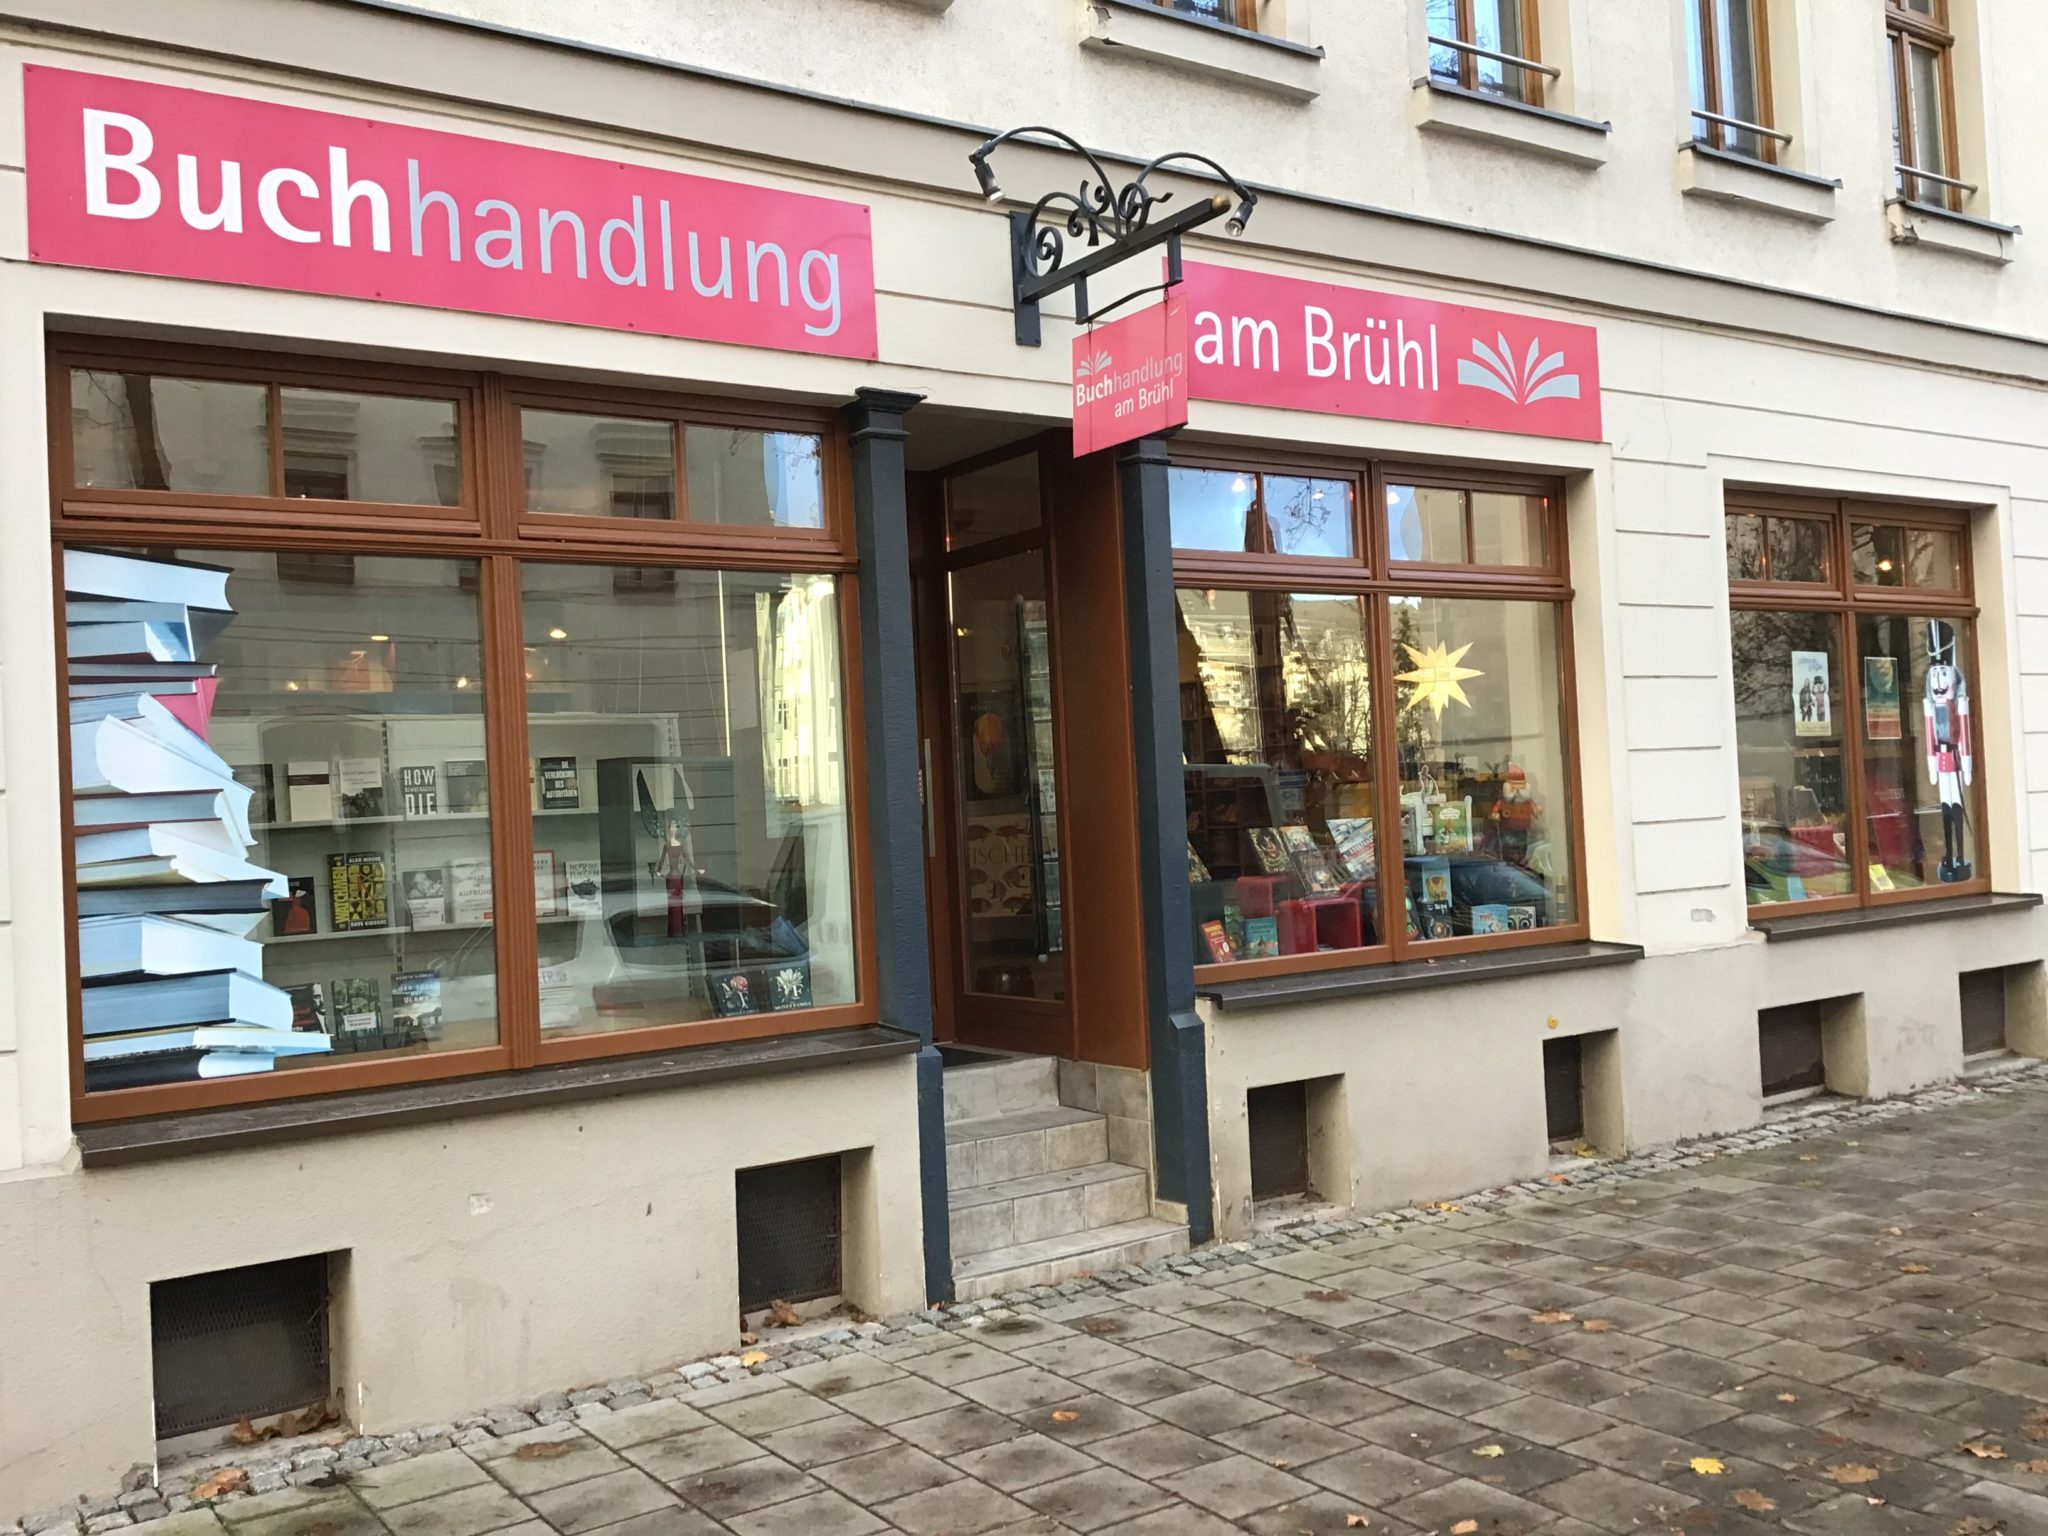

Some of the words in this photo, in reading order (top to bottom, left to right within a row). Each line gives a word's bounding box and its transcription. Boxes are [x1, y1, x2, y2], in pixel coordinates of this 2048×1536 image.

[83, 108, 841, 337] Buchhandlung
[1194, 310, 1280, 372] am
[1304, 305, 1439, 391] Brühl
[1076, 352, 1183, 407] Buchhandlung
[1114, 398, 1134, 418] am
[1138, 378, 1174, 410] Brühl
[404, 768, 435, 786] HOW
[405, 793, 437, 815] DIE
[332, 865, 350, 925] WATCHMEN
